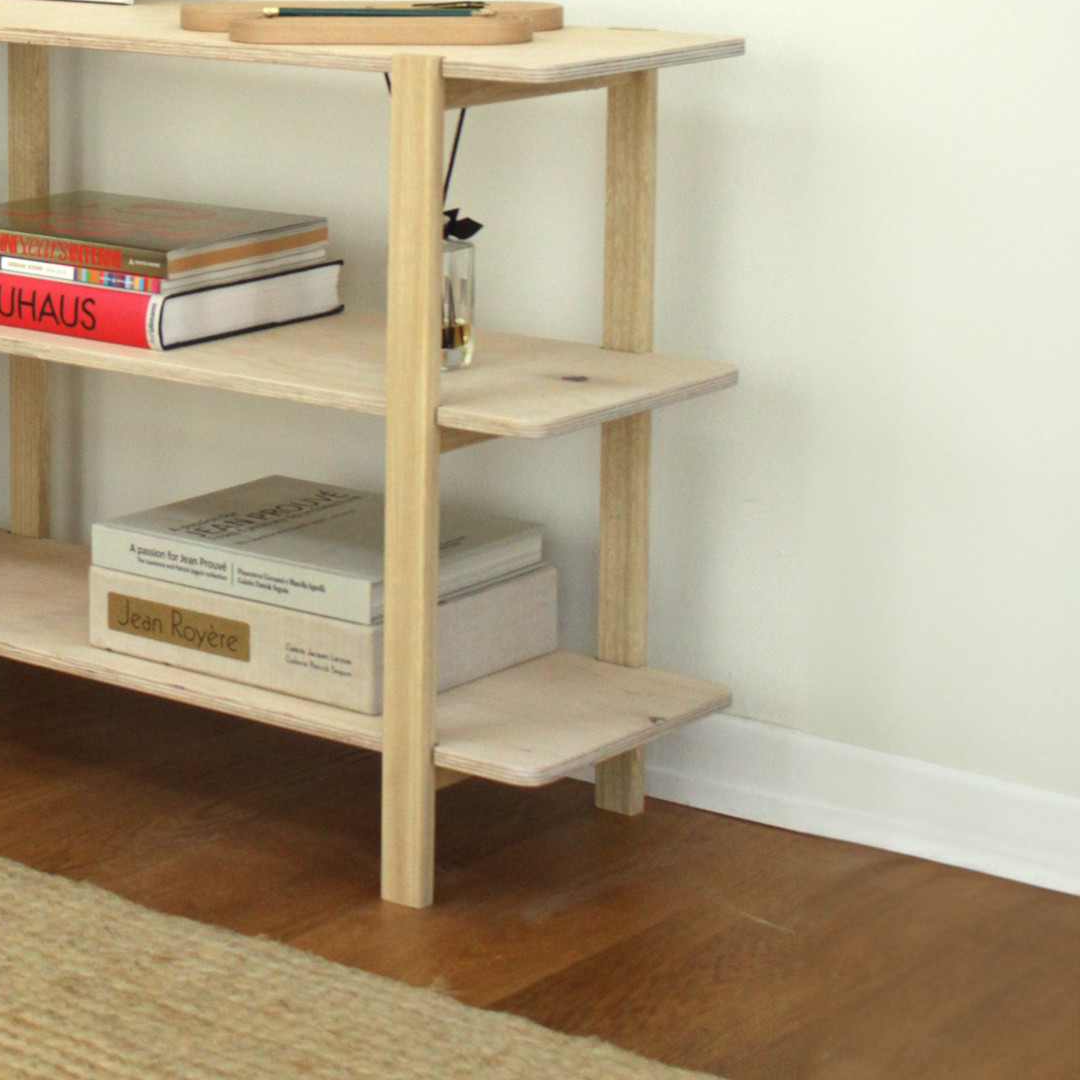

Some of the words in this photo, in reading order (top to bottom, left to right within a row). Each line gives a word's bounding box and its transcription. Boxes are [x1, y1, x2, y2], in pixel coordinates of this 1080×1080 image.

[129, 543, 136, 552] A
[137, 546, 165, 560] passion
[167, 549, 179, 561] for
[180, 553, 198, 565] Jean
[118, 597, 163, 633] Jean
[171, 608, 238, 652] Royère
